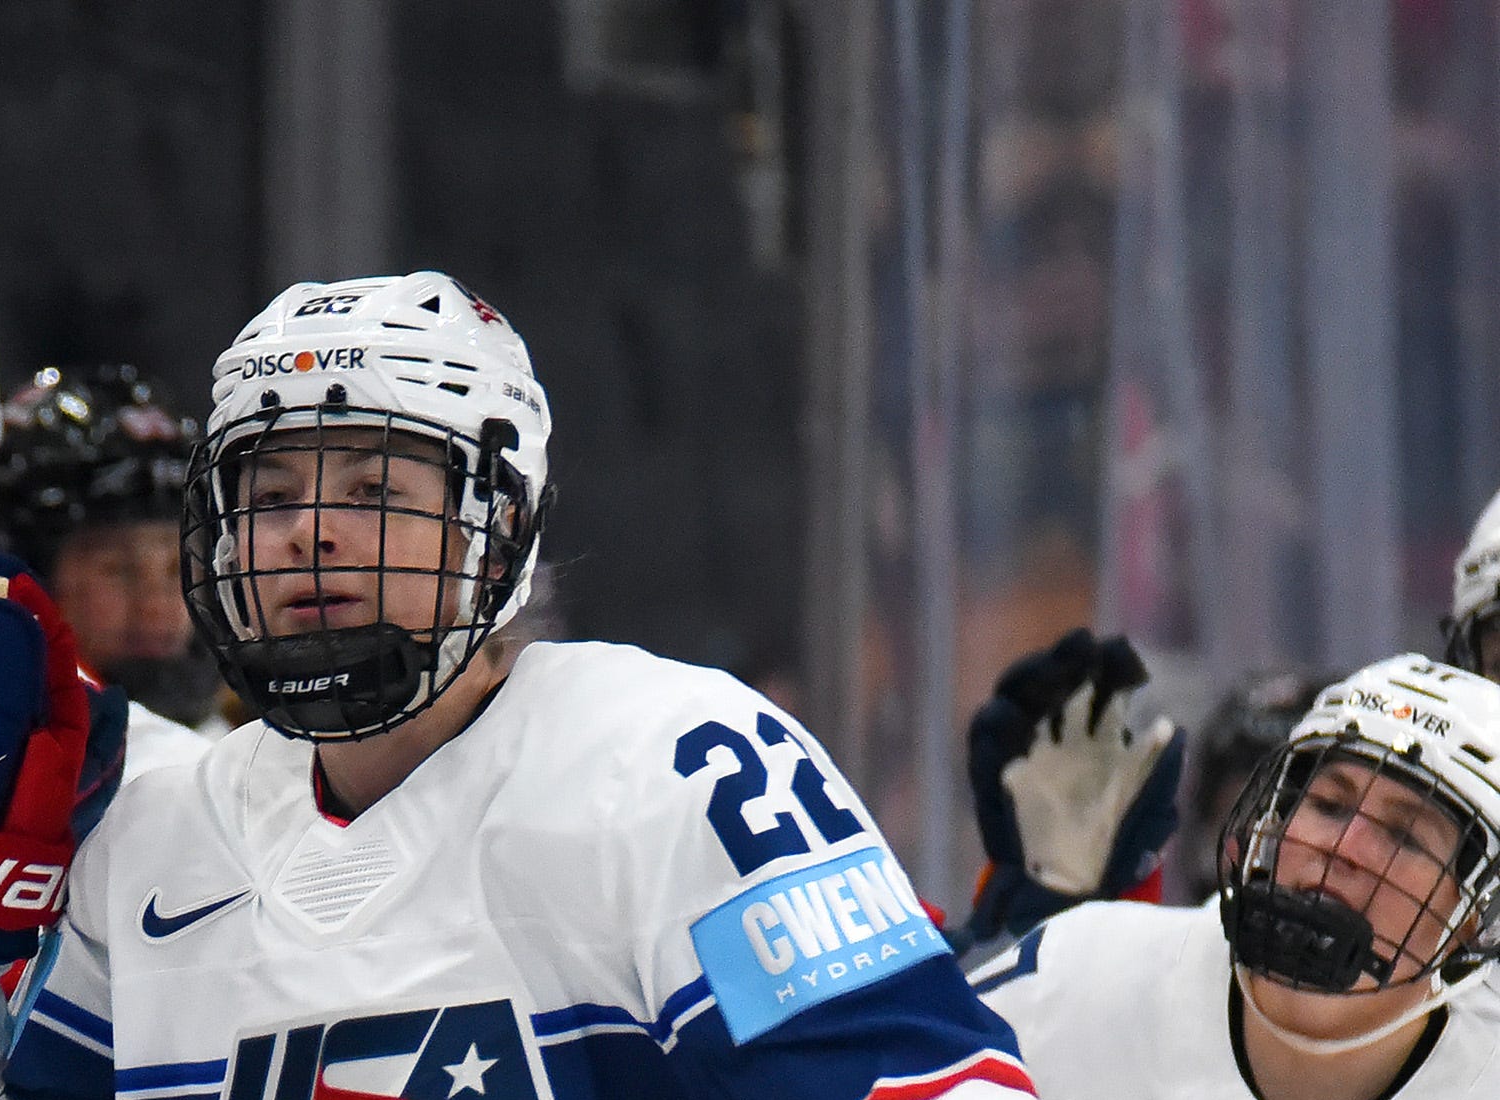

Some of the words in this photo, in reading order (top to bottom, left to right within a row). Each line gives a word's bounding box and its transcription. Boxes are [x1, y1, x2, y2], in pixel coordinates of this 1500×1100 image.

[294, 294, 365, 317] 22
[241, 347, 369, 381] DISCOVER
[1350, 689, 1451, 738] DISCOVER
[673, 711, 866, 878] 22
